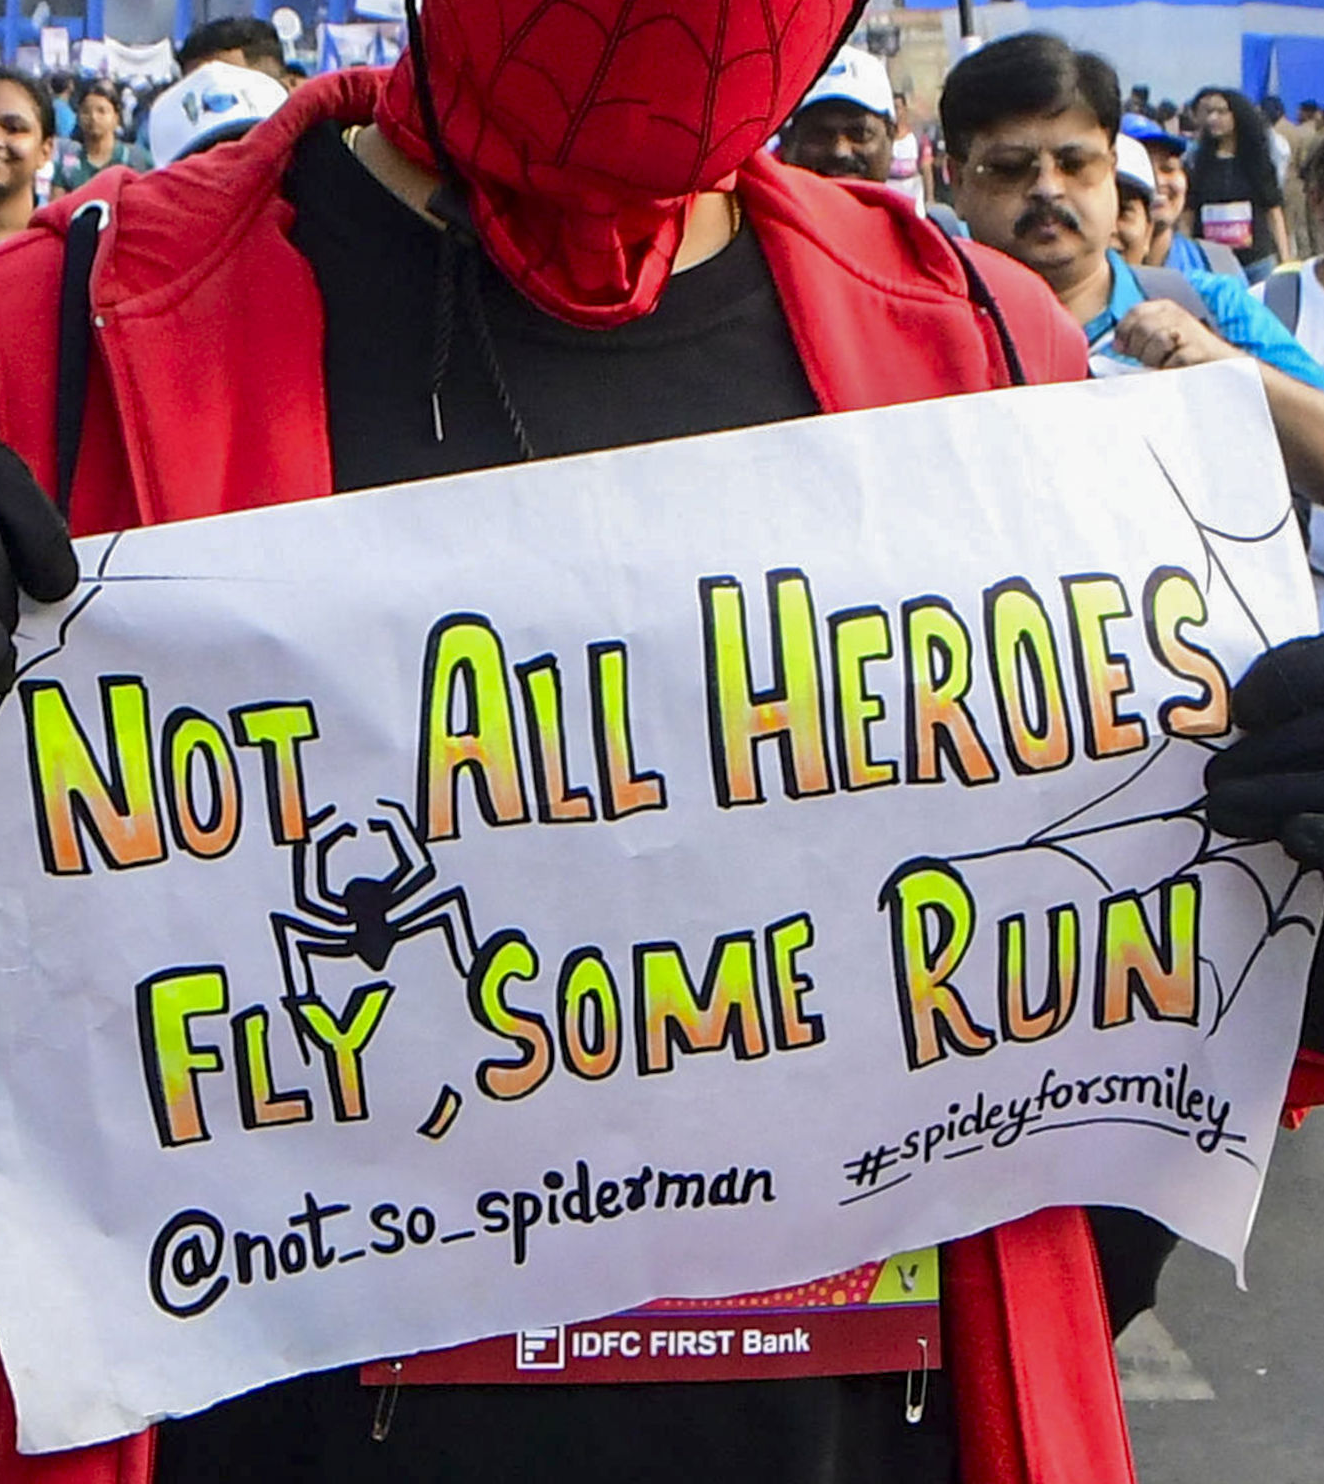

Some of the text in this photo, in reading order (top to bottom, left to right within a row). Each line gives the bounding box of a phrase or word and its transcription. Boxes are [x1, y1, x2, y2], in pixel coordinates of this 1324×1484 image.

[19, 565, 1233, 876] NOT ALL HEROES
[467, 911, 826, 1101] SOME
[878, 856, 1201, 1072] RUN
[842, 1062, 1247, 1187] #spideyforsmiley
[148, 1160, 776, 1319] @not_so_spiderman
[571, 1327, 811, 1358] IDFC FIRST Bank
